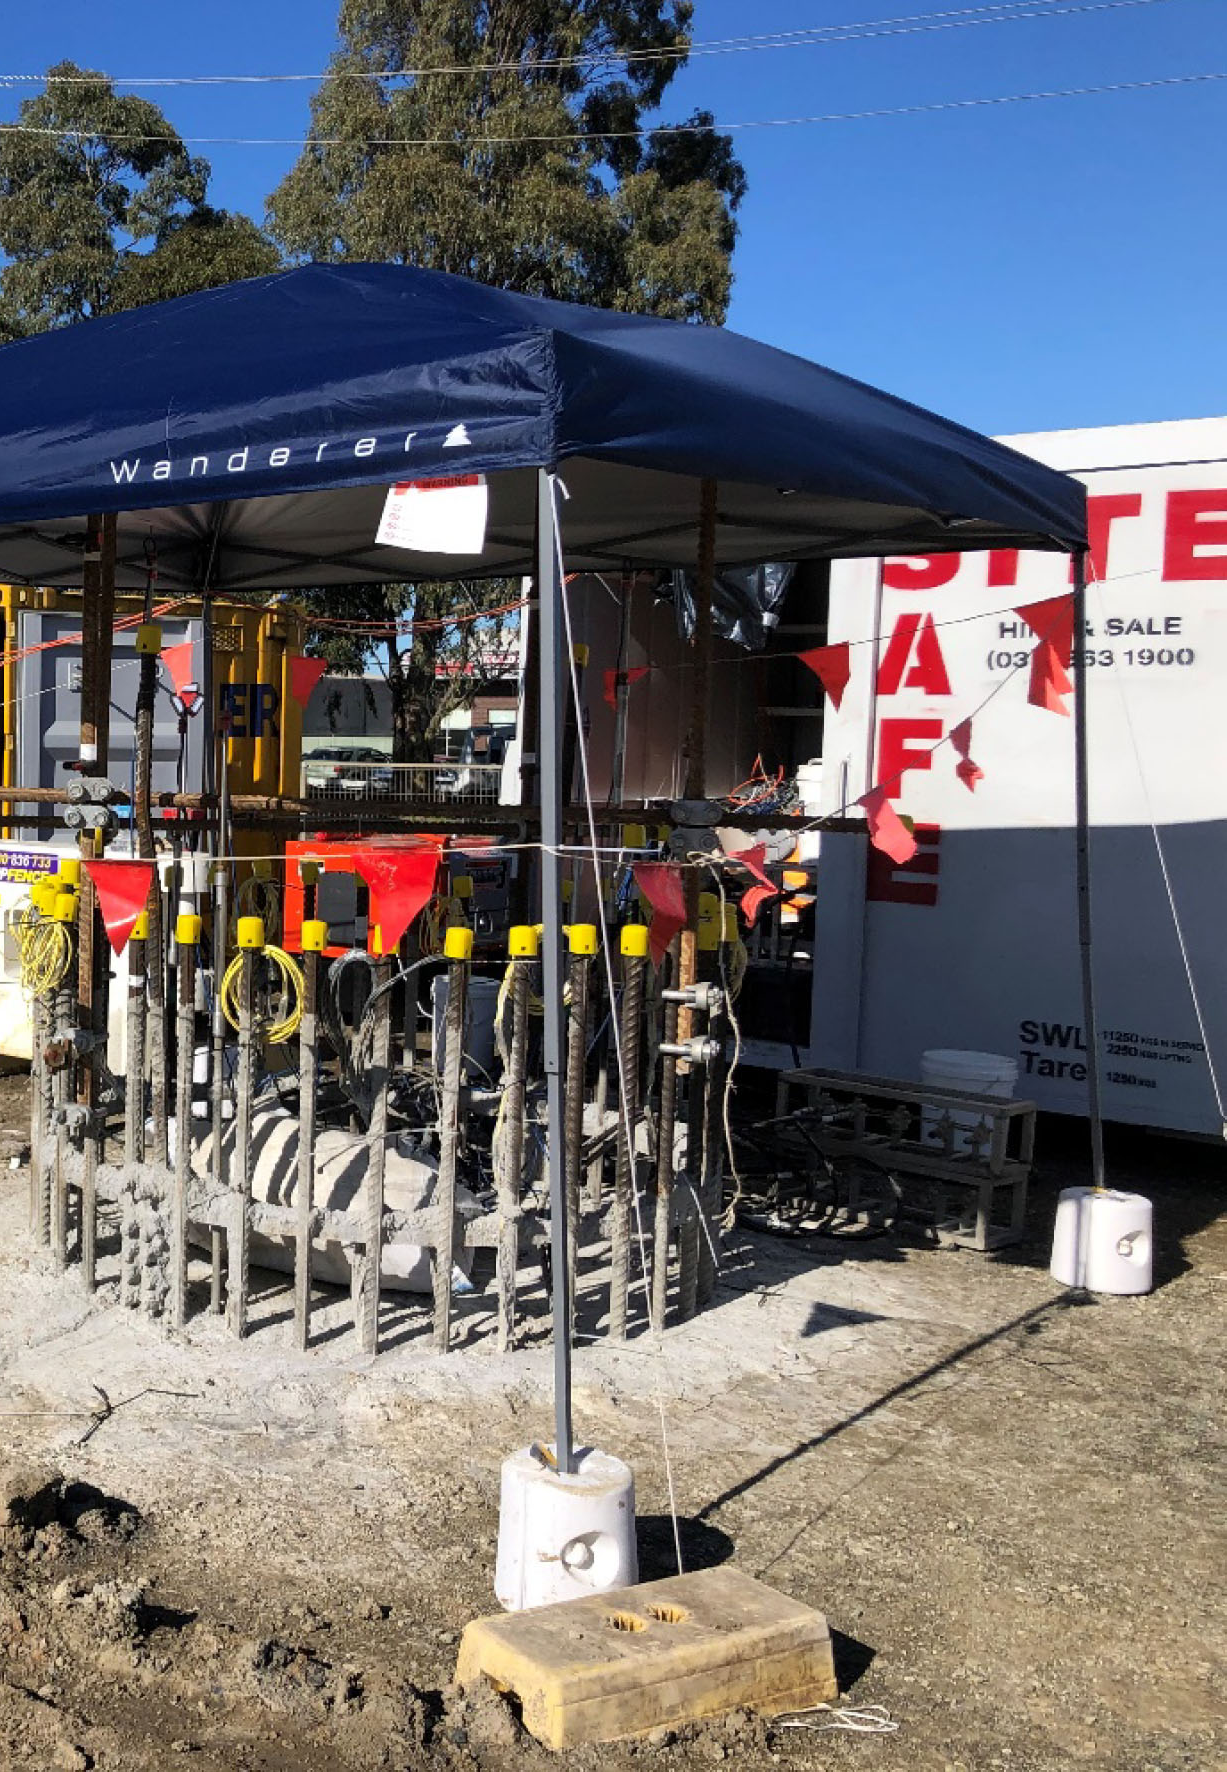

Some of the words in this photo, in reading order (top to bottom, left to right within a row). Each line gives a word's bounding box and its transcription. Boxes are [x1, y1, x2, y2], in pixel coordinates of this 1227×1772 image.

[110, 431, 417, 484] Wanderer
[1106, 616, 1182, 637] SALE
[1123, 647, 1196, 666] 1900
[1019, 1020, 1087, 1051] SWL
[1019, 1050, 1087, 1082] Tare
